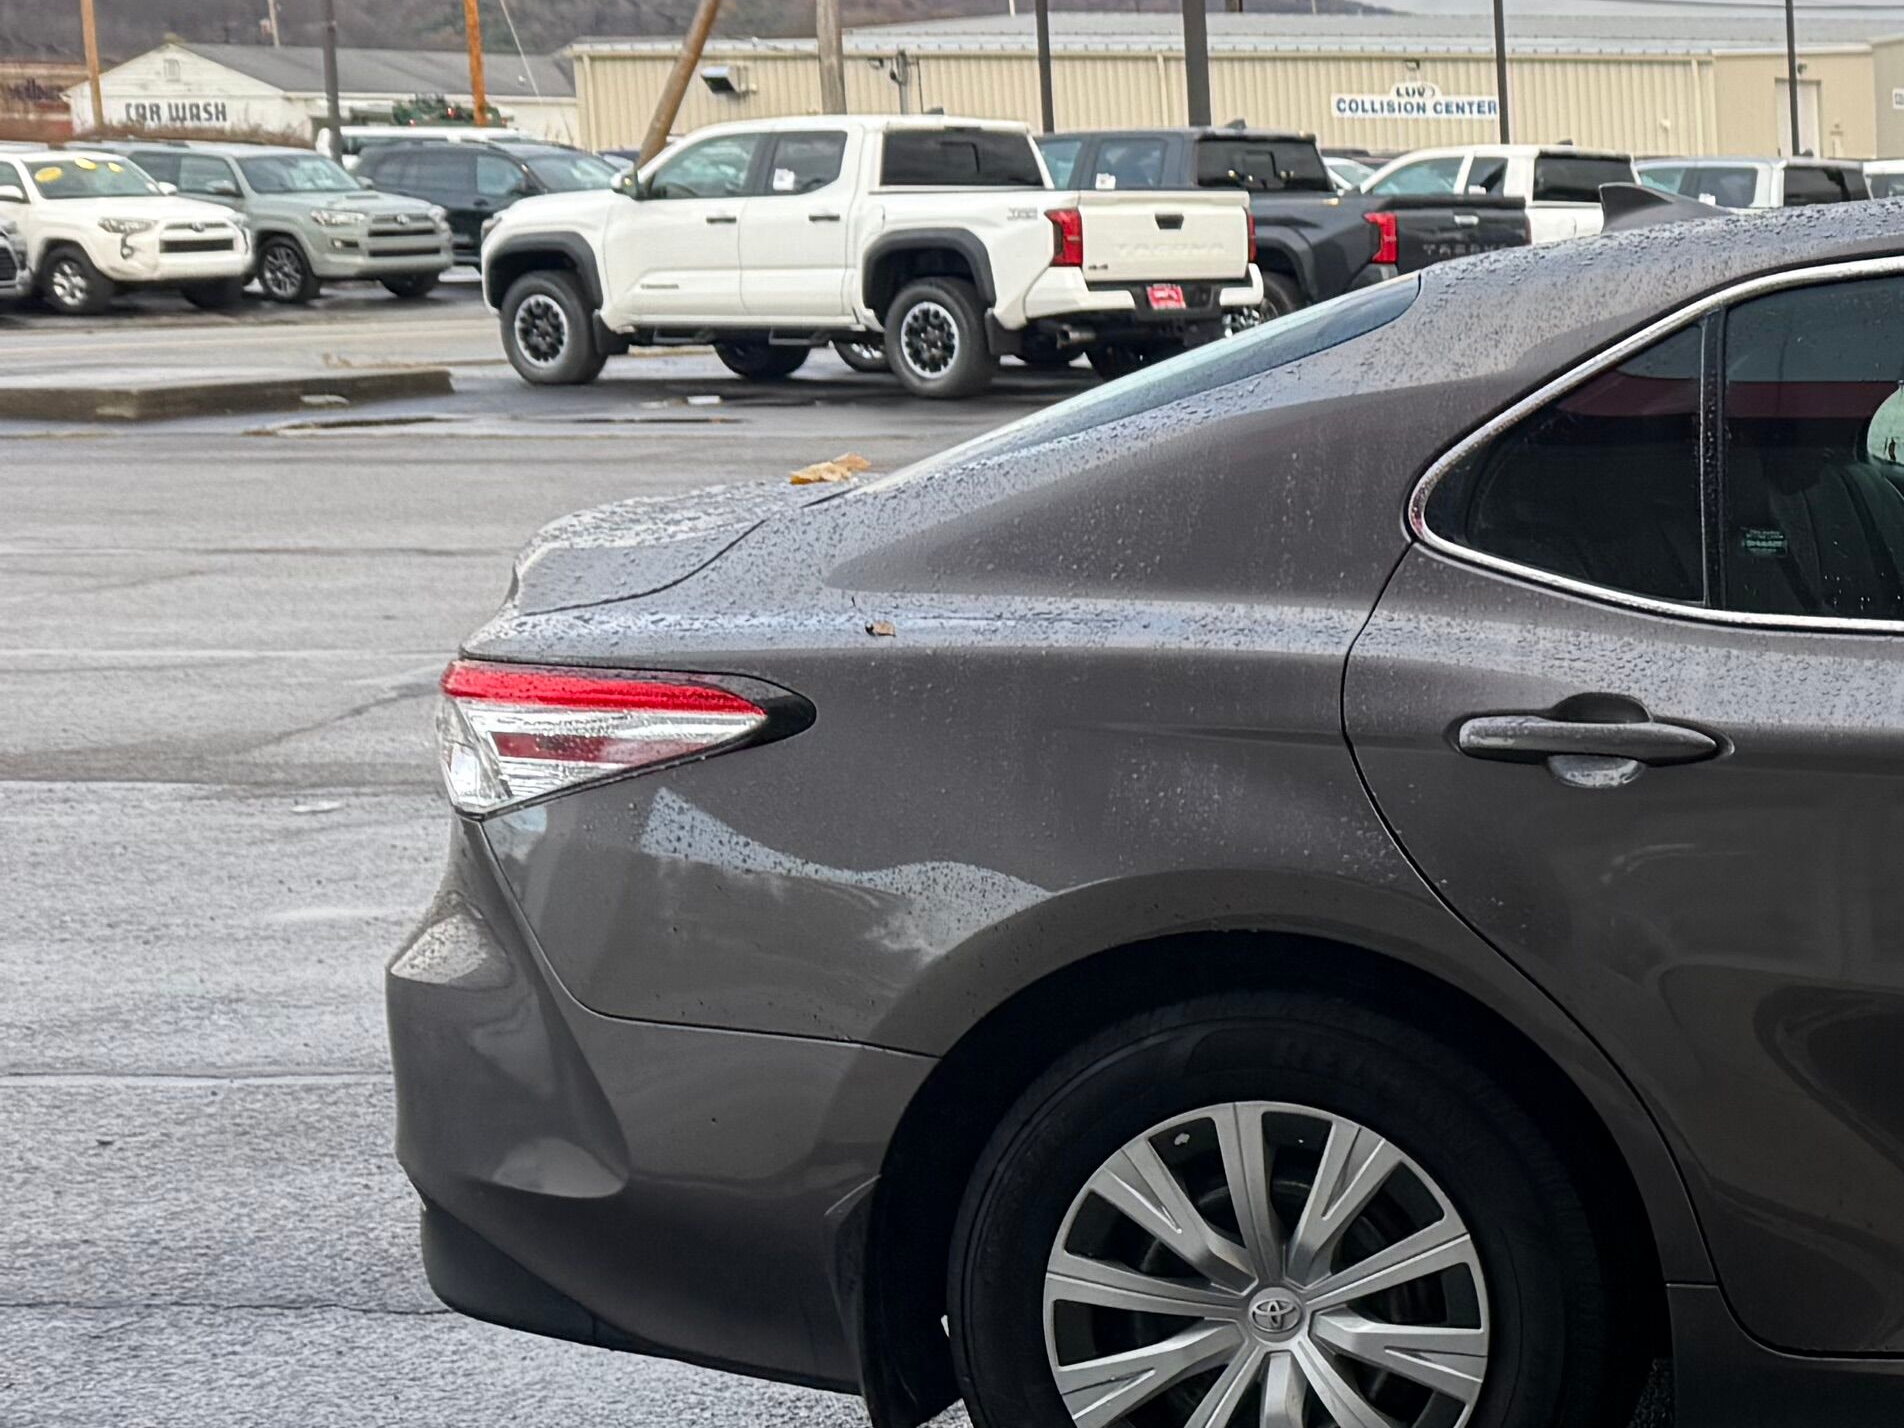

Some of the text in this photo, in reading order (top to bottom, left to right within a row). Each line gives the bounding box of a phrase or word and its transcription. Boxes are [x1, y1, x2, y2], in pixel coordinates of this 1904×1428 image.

[125, 102, 227, 123] CAR WASH
[1336, 97, 1498, 115] COLLISION CENTER
